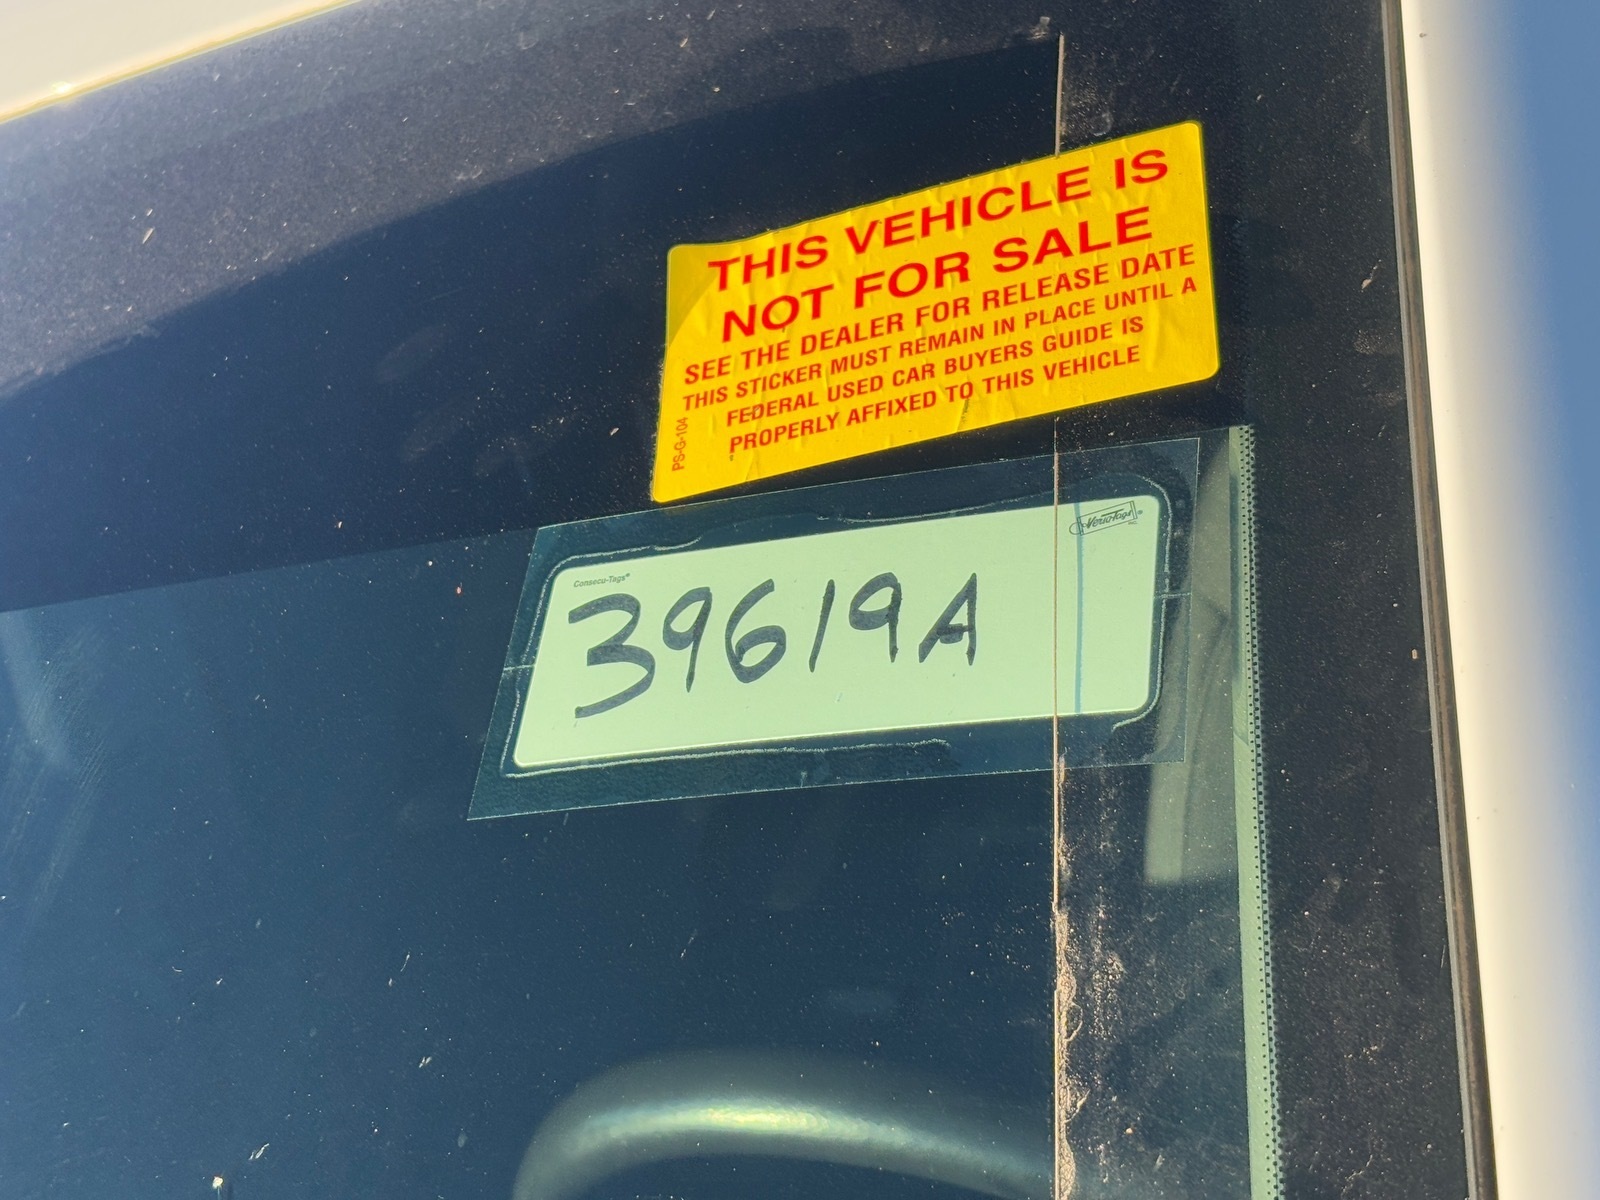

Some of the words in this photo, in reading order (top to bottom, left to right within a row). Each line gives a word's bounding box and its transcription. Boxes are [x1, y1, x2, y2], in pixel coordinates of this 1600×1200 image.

[707, 235, 829, 292] THIS
[845, 165, 1092, 255] VEHICLE
[1114, 148, 1169, 190] IS
[722, 284, 835, 343] NOT
[853, 251, 971, 309] FOR
[993, 206, 1153, 273] SALE
[683, 386, 728, 411] THIS
[735, 362, 822, 399] STICKER
[830, 345, 892, 375] MUST
[899, 323, 985, 358] REMAIN
[993, 316, 1016, 337] IN
[1024, 298, 1096, 329] PLACE
[1104, 282, 1173, 311] UNTIL
[1181, 276, 1197, 294] A
[684, 355, 731, 385] SEE
[741, 340, 790, 370] THE
[800, 312, 904, 356] DEALER
[915, 296, 971, 328] FOR
[982, 263, 1109, 312] RELEASE
[1120, 243, 1195, 286] DATE
[726, 391, 819, 427] FEDERAL
[827, 375, 884, 403] USED
[892, 362, 936, 387] CAR
[944, 340, 1034, 375] BUYERS
[1042, 322, 1113, 353] GUIDE
[1121, 315, 1144, 334] IS
[671, 416, 689, 472] PS-G-104
[729, 412, 840, 454] PROPERLY
[846, 390, 937, 426] AFFIXED
[945, 381, 974, 403] TO
[982, 368, 1035, 394] THIS
[1042, 345, 1140, 381] VEHICLE
[568, 572, 978, 720] 39619A
